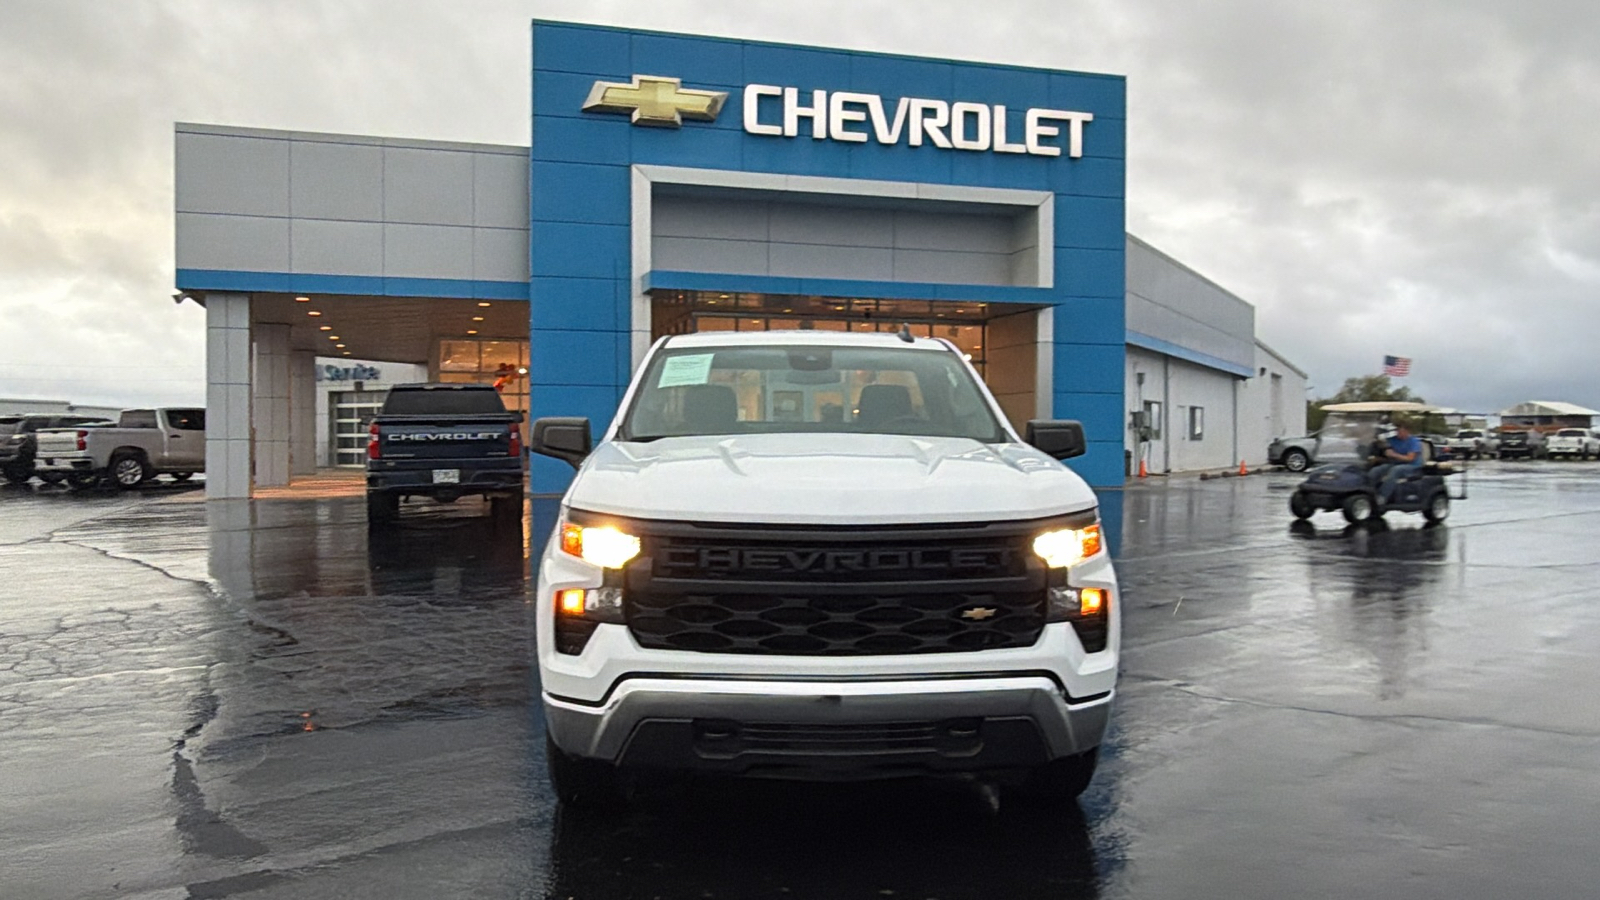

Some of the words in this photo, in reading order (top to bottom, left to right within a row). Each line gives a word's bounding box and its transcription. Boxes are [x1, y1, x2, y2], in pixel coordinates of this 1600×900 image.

[743, 84, 1094, 158] CHEVROLET
[388, 432, 502, 441] CHEVROLET
[659, 546, 1018, 573] CHEVROLET
